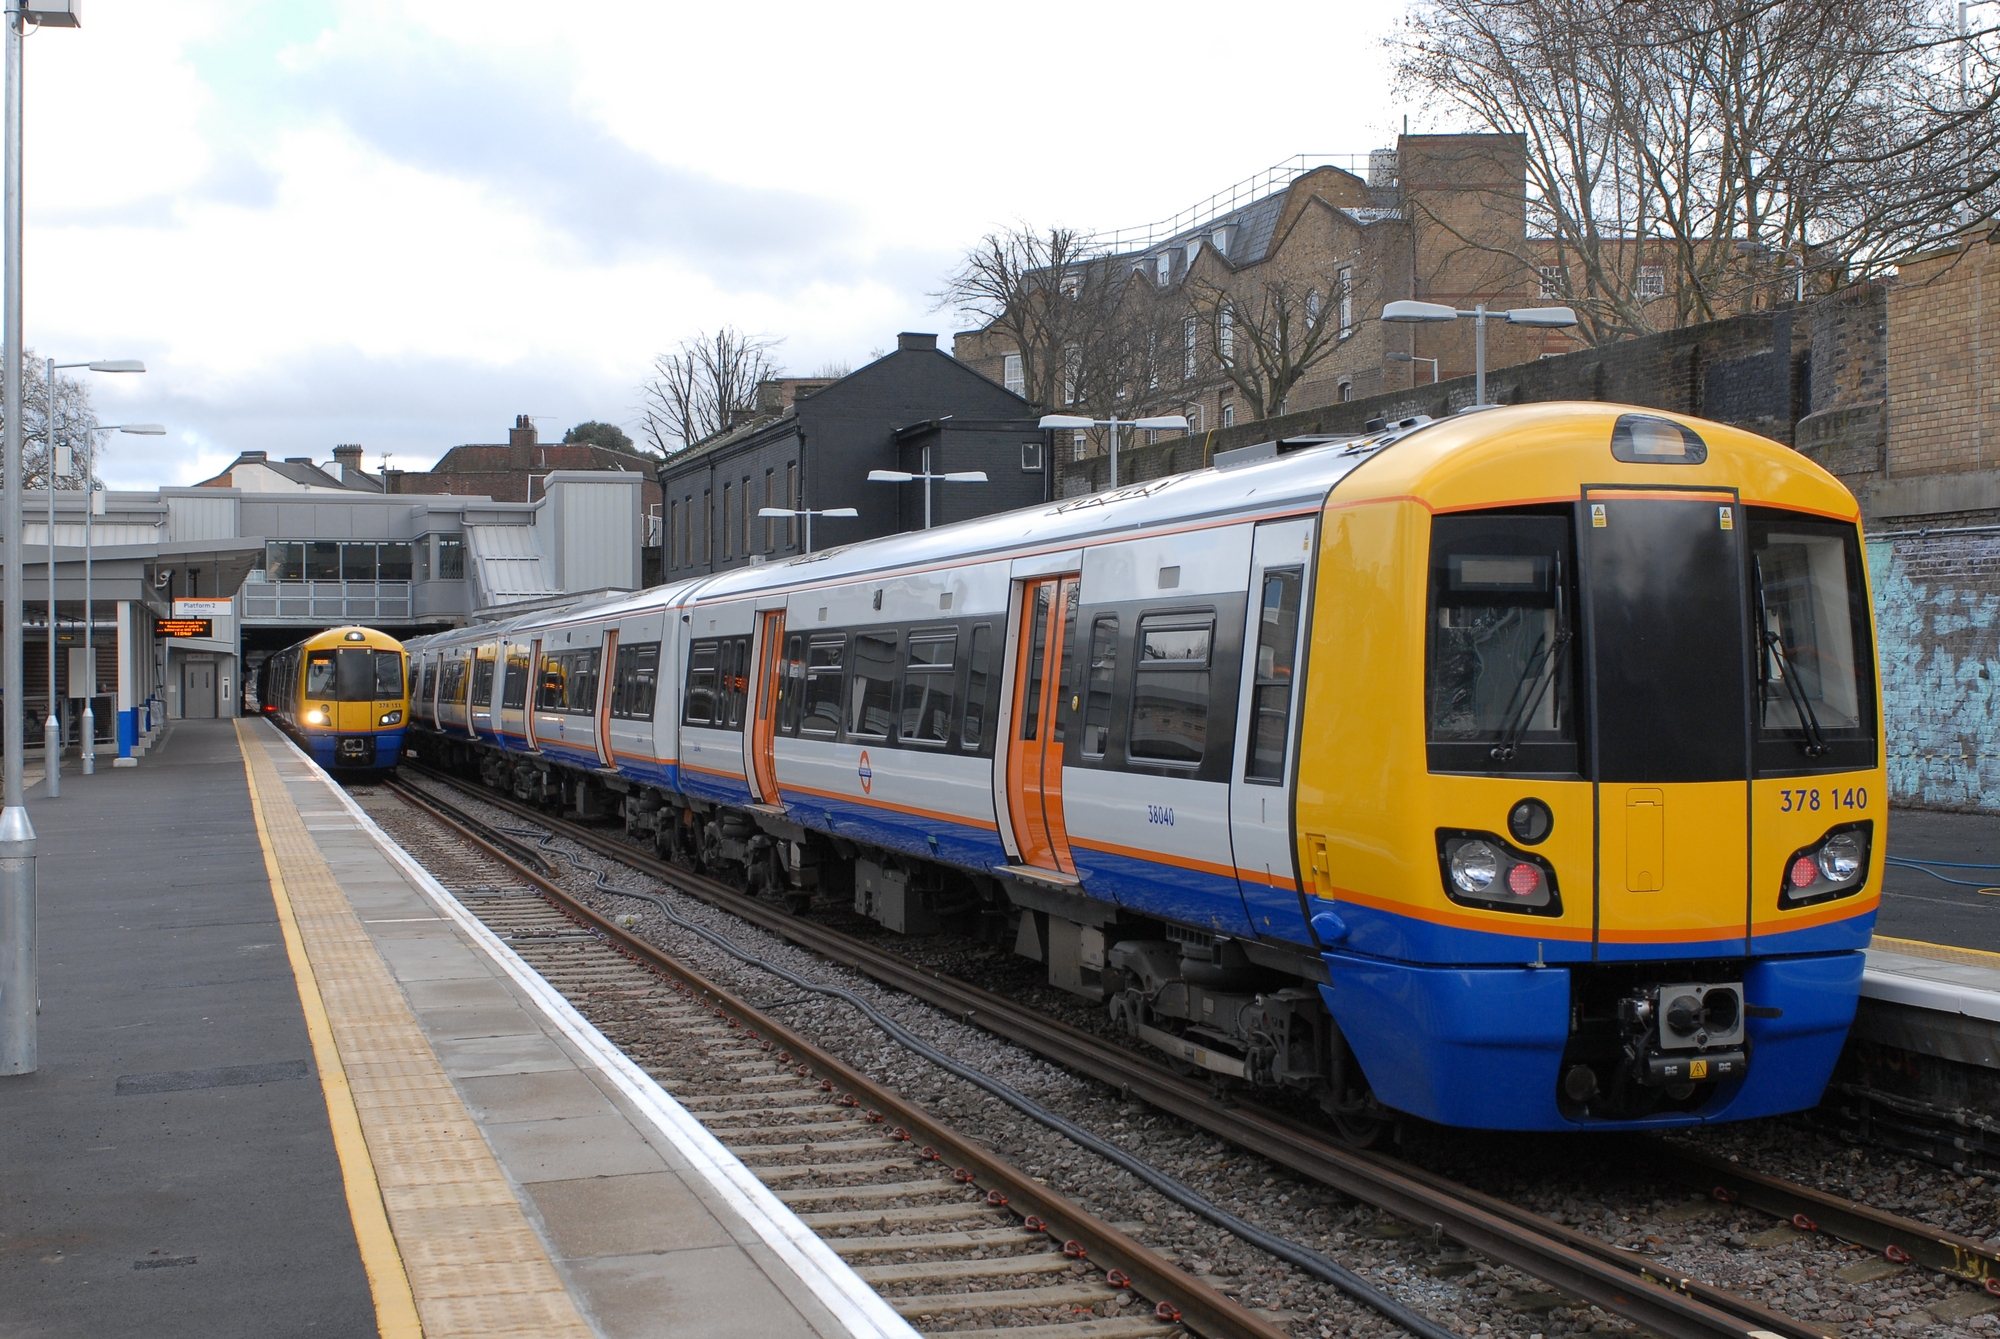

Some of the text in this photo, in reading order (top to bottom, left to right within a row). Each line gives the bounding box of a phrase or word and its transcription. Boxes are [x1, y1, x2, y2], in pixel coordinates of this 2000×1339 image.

[1780, 787, 1868, 812] 378 140
[1147, 804, 1175, 826] 38040
